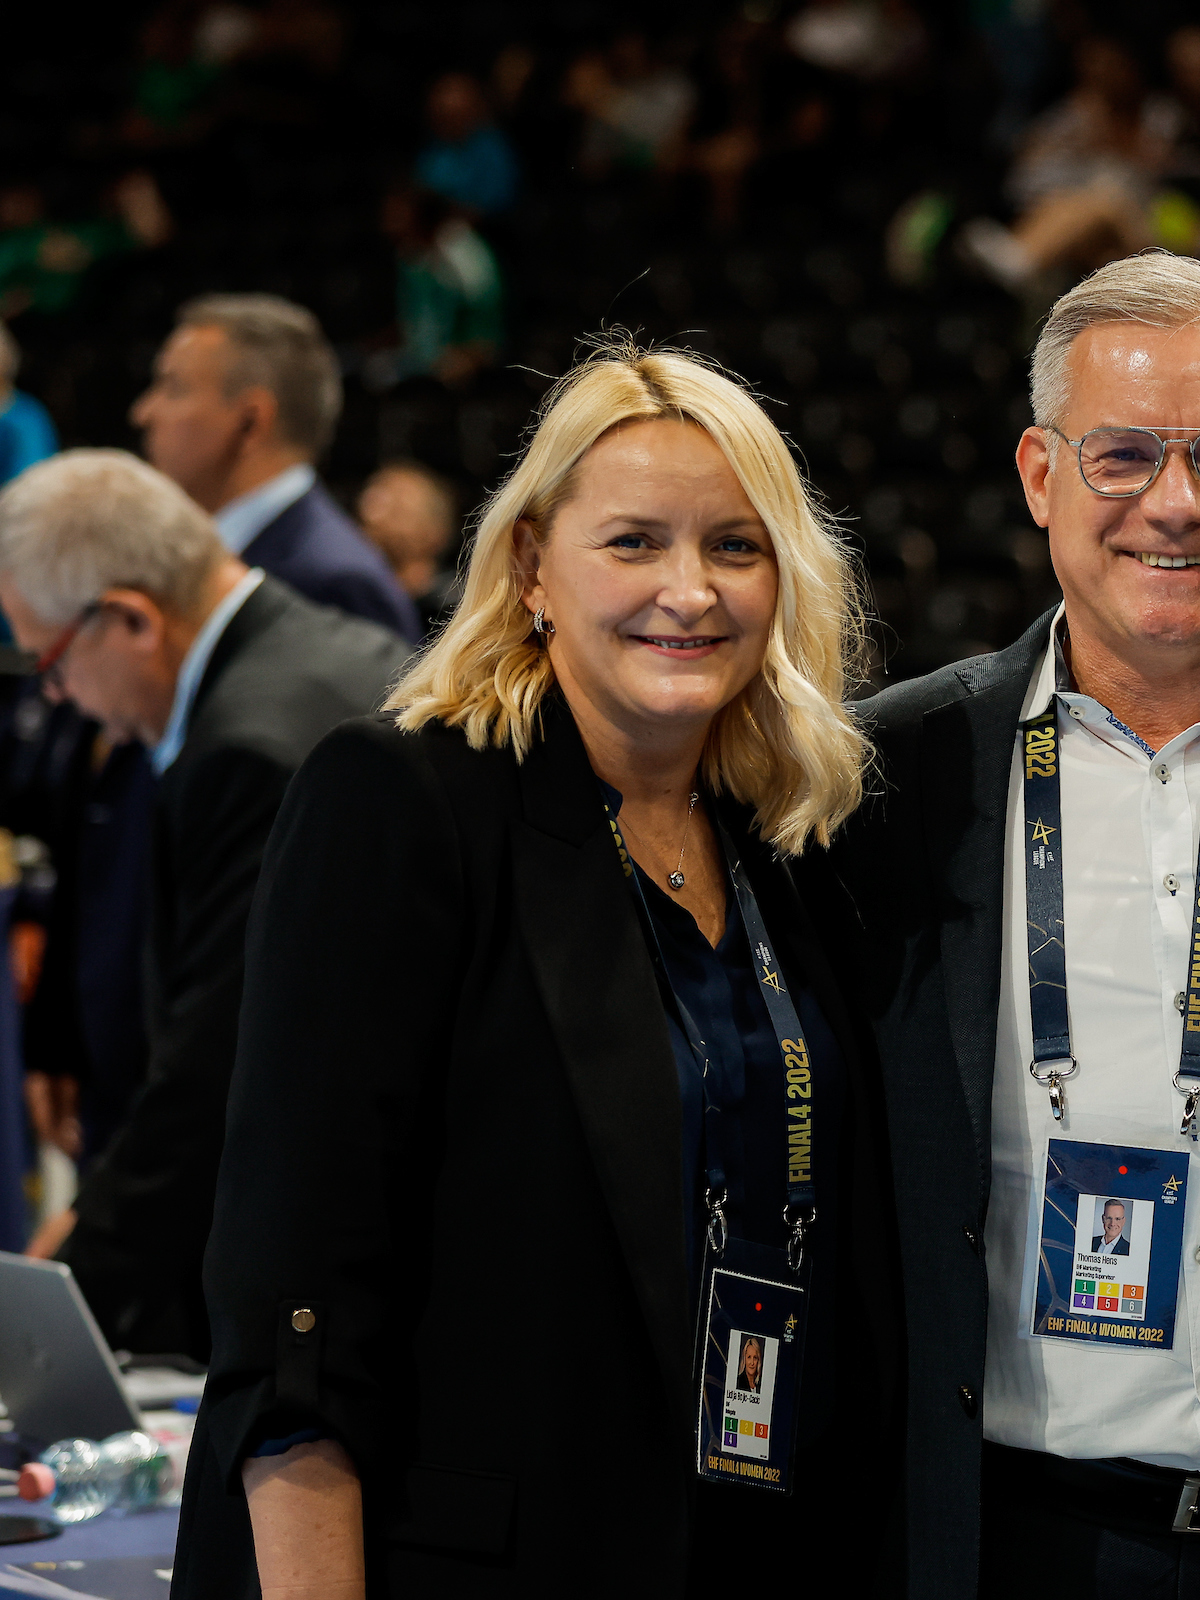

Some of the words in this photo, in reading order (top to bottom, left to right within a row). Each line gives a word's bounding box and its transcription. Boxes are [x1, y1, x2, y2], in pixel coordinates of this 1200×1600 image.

[1026, 727, 1056, 780] 2022
[781, 1038, 812, 1099] 2022
[788, 1105, 812, 1182] FINAL4
[1077, 1253, 1101, 1264] Thomas
[1102, 1255, 1118, 1266] Hens
[1082, 1281, 1087, 1292] 1
[1106, 1284, 1112, 1294] 2
[1130, 1286, 1136, 1297] 3
[1081, 1296, 1086, 1306] 4
[1105, 1298, 1111, 1309] 5
[1129, 1301, 1135, 1311] 6
[1047, 1317, 1065, 1332] EHF
[1065, 1319, 1097, 1335] FINAL4
[1099, 1323, 1137, 1340] WOMEN
[1138, 1327, 1164, 1343] 2022
[759, 1425, 764, 1436] 3
[708, 1455, 719, 1470] EHF
[719, 1457, 739, 1474] FINAL4
[740, 1461, 763, 1479] WOMEN
[764, 1467, 781, 1483] 2022
